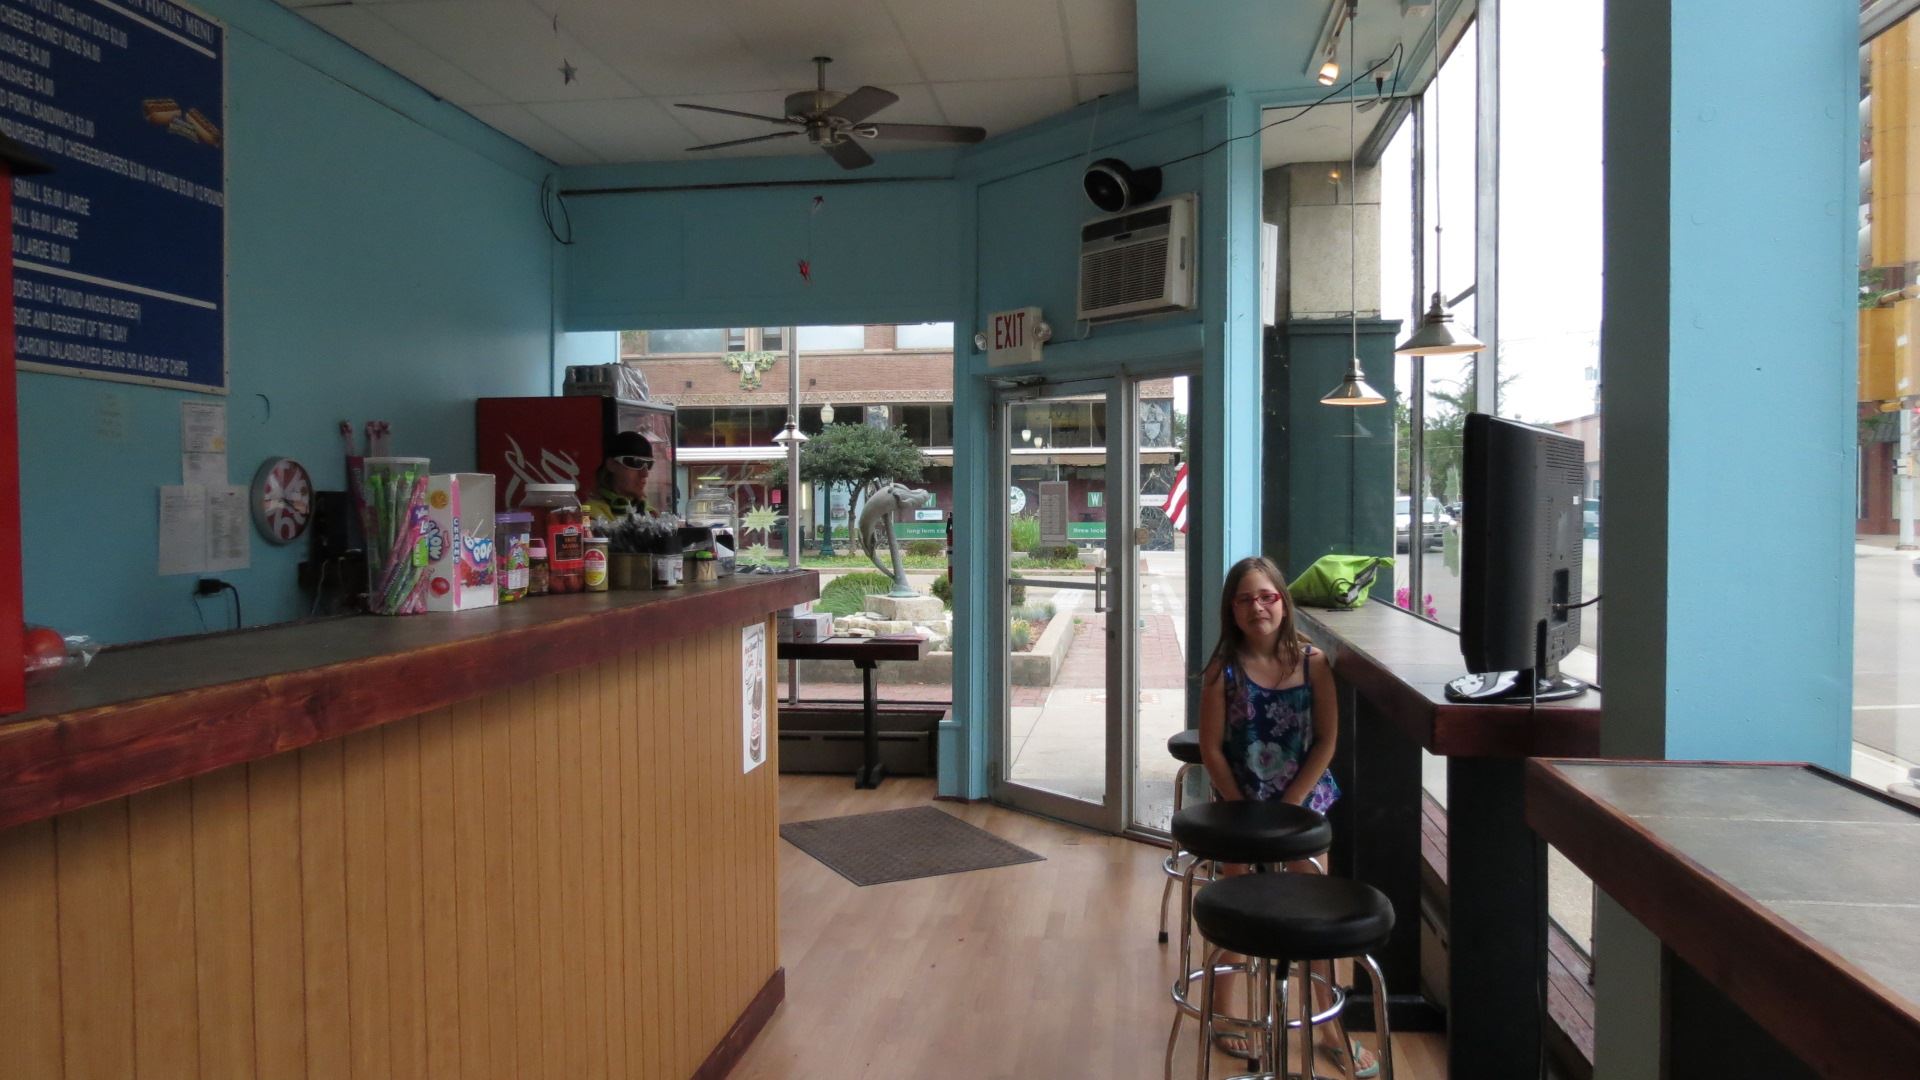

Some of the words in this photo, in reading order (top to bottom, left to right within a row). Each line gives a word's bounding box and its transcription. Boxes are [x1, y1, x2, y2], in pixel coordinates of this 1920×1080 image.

[0, 3, 34, 35] CHEESE
[35, 18, 62, 47] CONEY
[64, 31, 80, 54] DOG
[76, 10, 91, 33] HOT
[92, 17, 109, 41] DOG
[185, 13, 212, 44] MENU
[8, 91, 32, 116] PORK
[32, 100, 74, 132] SANDWICH
[46, 131, 64, 154] AND
[64, 138, 128, 175] CHEESEBURGERS
[156, 170, 178, 192] POUND
[14, 176, 41, 202] SMALL
[64, 191, 90, 216] LARGE
[22, 235, 50, 259] LARGE
[52, 216, 79, 240] LARGE
[34, 282, 56, 303] HALF
[56, 287, 83, 309] POUND
[84, 293, 110, 314] ANGUS
[110, 298, 141, 320] BURGER
[14, 305, 32, 326] SIDE
[32, 309, 50, 329] AND
[51, 312, 86, 335] DESSERT
[86, 319, 98, 337] OF
[98, 321, 112, 340] THE
[112, 324, 128, 343] DAY
[995, 312, 1025, 350] EXIT
[102, 348, 126, 367] BEANS
[126, 352, 136, 369] OR
[137, 353, 144, 370] A
[144, 354, 158, 372] BAG
[159, 357, 168, 374] OF
[169, 358, 188, 377] CHIPS
[452, 517, 461, 563] CHARMS
[473, 541, 493, 562] POP
